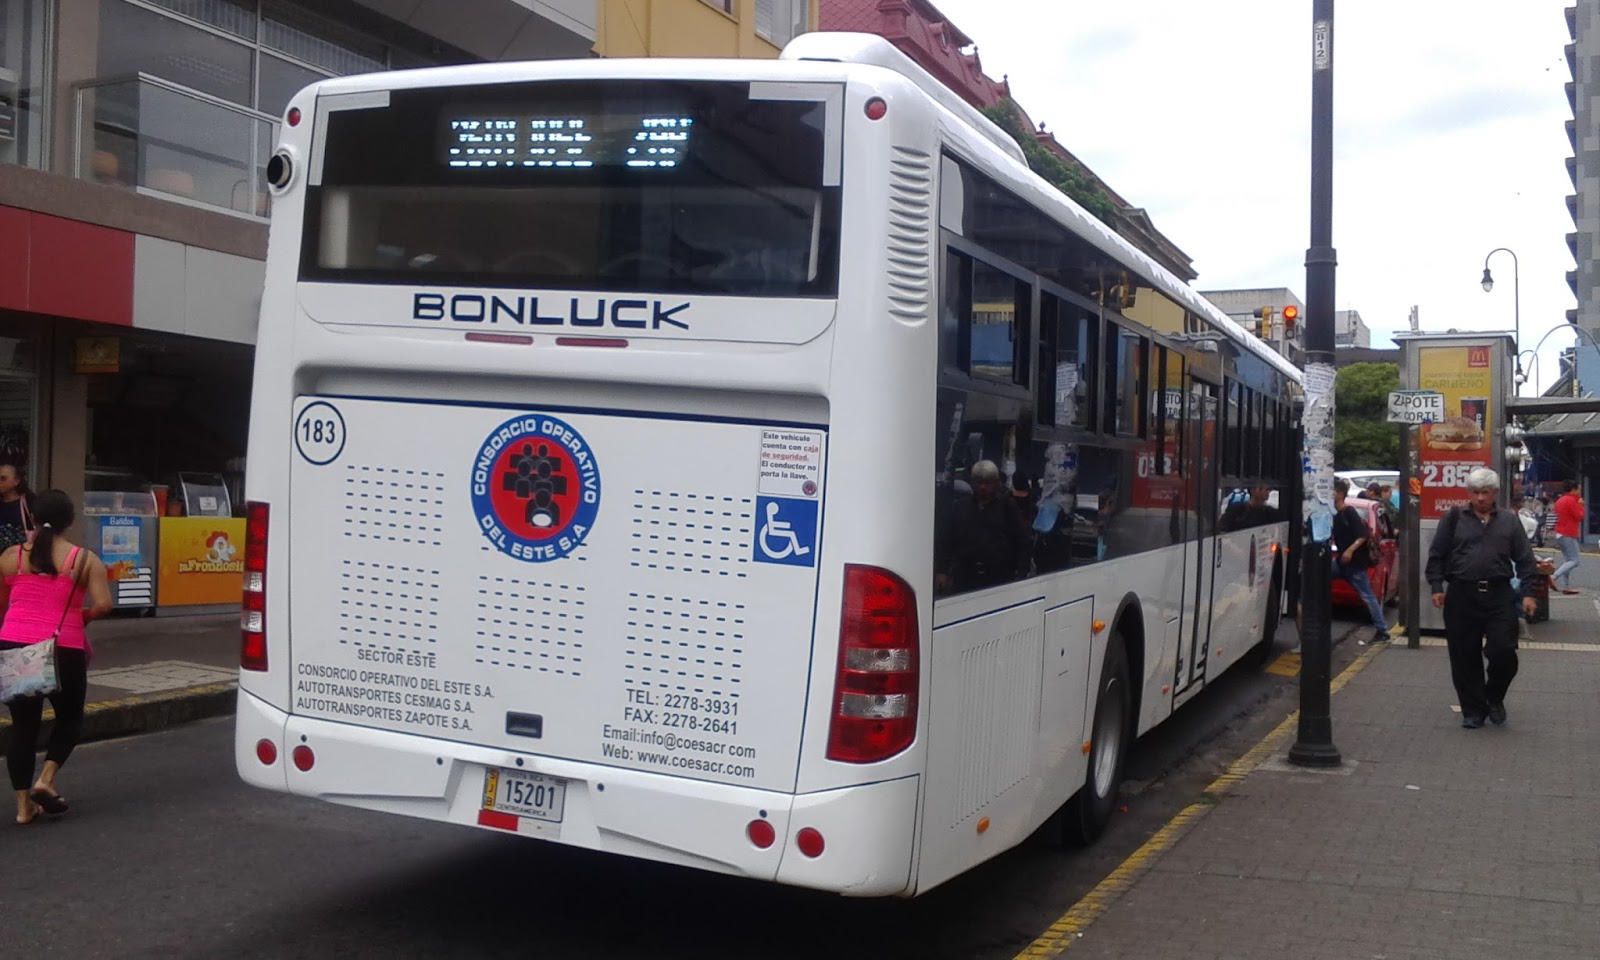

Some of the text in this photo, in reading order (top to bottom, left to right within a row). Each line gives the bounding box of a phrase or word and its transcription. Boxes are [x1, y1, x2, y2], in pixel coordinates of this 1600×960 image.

[413, 293, 690, 330] BONLUCK
[1393, 395, 1439, 408] ZAPOTE
[1404, 411, 1439, 421] CORTE
[303, 418, 335, 444] 183
[763, 432, 779, 440] Este
[474, 418, 597, 504] CONSORCIO OPERATIVO
[803, 445, 819, 453] caja
[770, 461, 806, 470] conductor
[790, 472, 809, 480] llave.
[481, 514, 586, 560] DEL ESTE S.A
[357, 648, 437, 669] SECTOR ESTE
[298, 663, 495, 698] CONSORCIO OPERATIVO DEL ESTE S.A.
[297, 680, 475, 714] AUTOTRANSPORTES CESMAG S.A.
[626, 688, 738, 716] TEL: 2278-3931
[297, 697, 473, 731] AUTOTRANSPORTES ZAPOTE S.A.
[624, 706, 737, 735] FAX: 2278-2641
[602, 742, 755, 778] Web: www.coesacr.com
[506, 779, 555, 809] 15201
